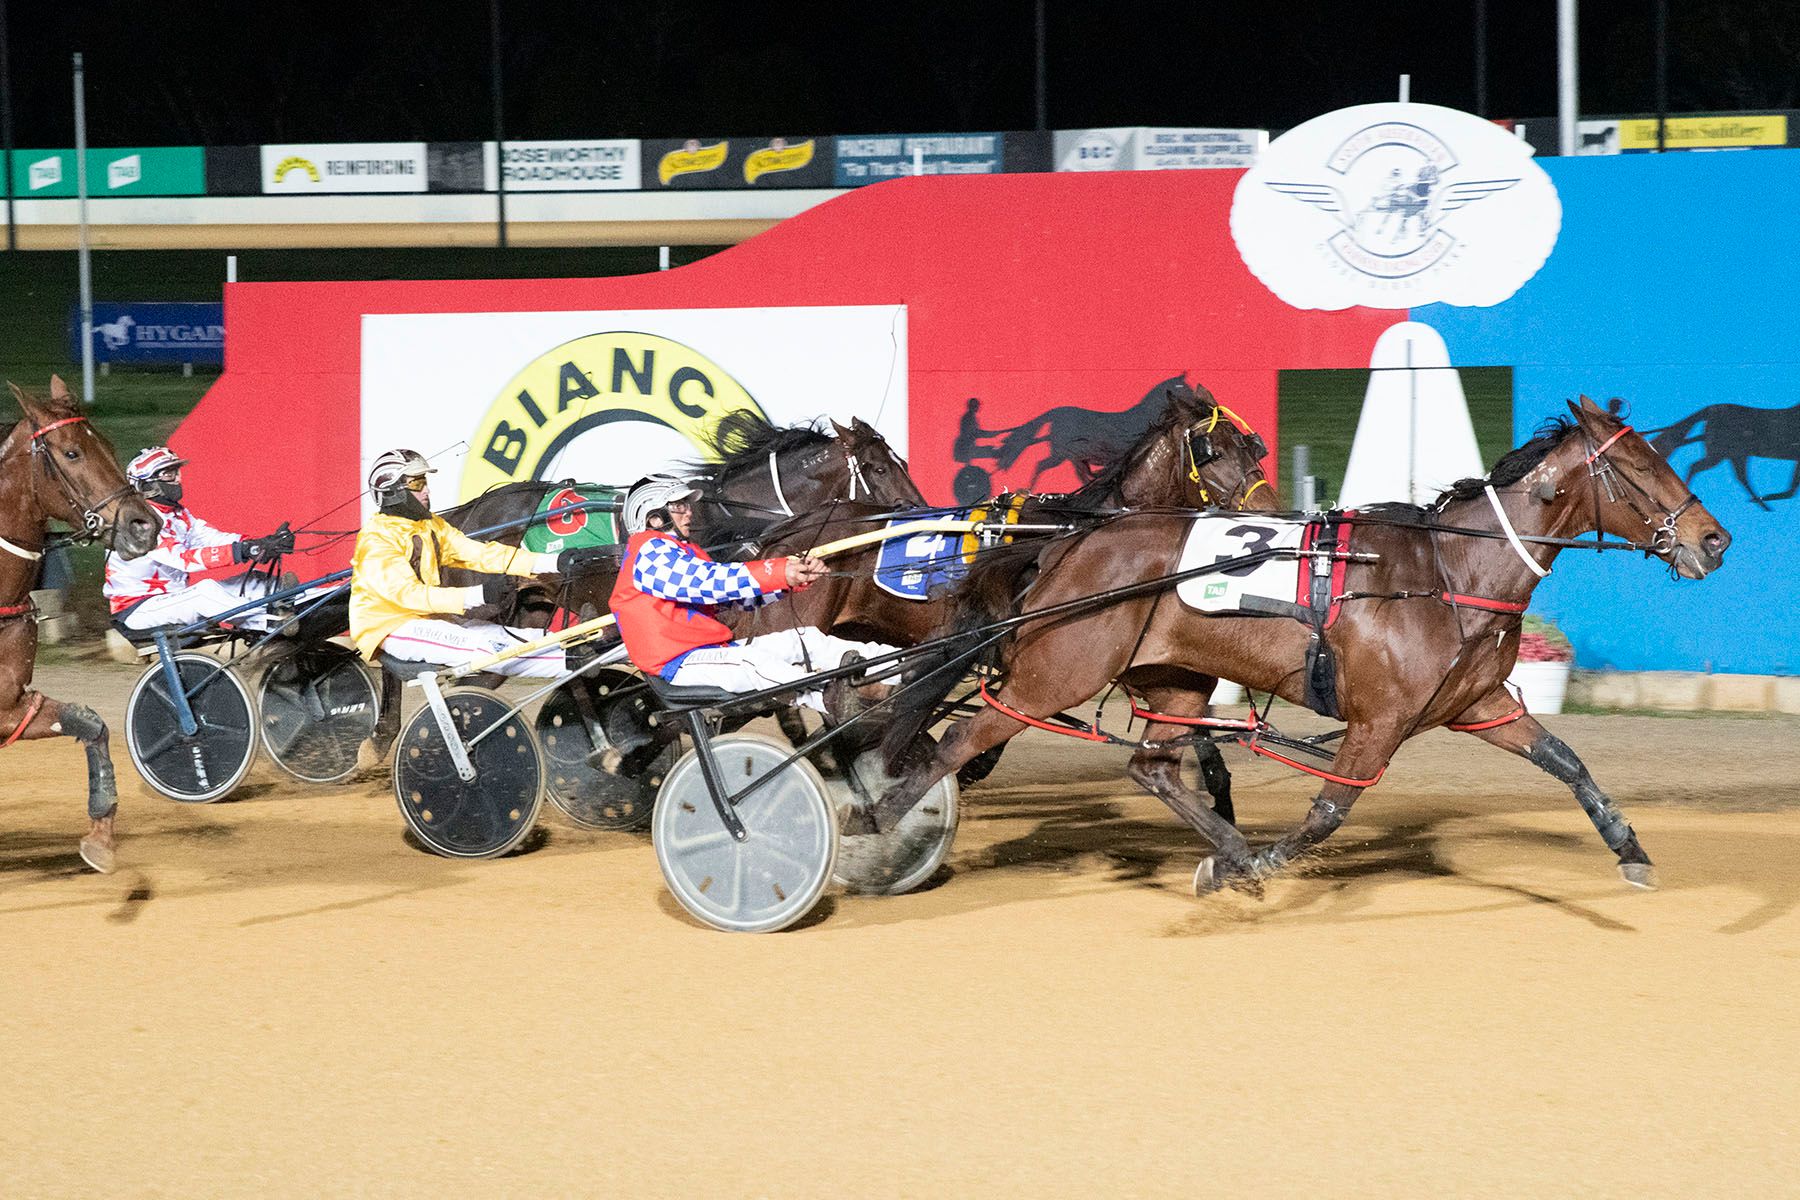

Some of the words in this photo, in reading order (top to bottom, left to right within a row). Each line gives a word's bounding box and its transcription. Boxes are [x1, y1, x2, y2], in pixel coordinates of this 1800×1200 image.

[326, 159, 415, 175] REINFORCING
[503, 166, 622, 181] ROADHOUSE
[1214, 524, 1279, 577] 3
[1207, 585, 1226, 596] TAB
